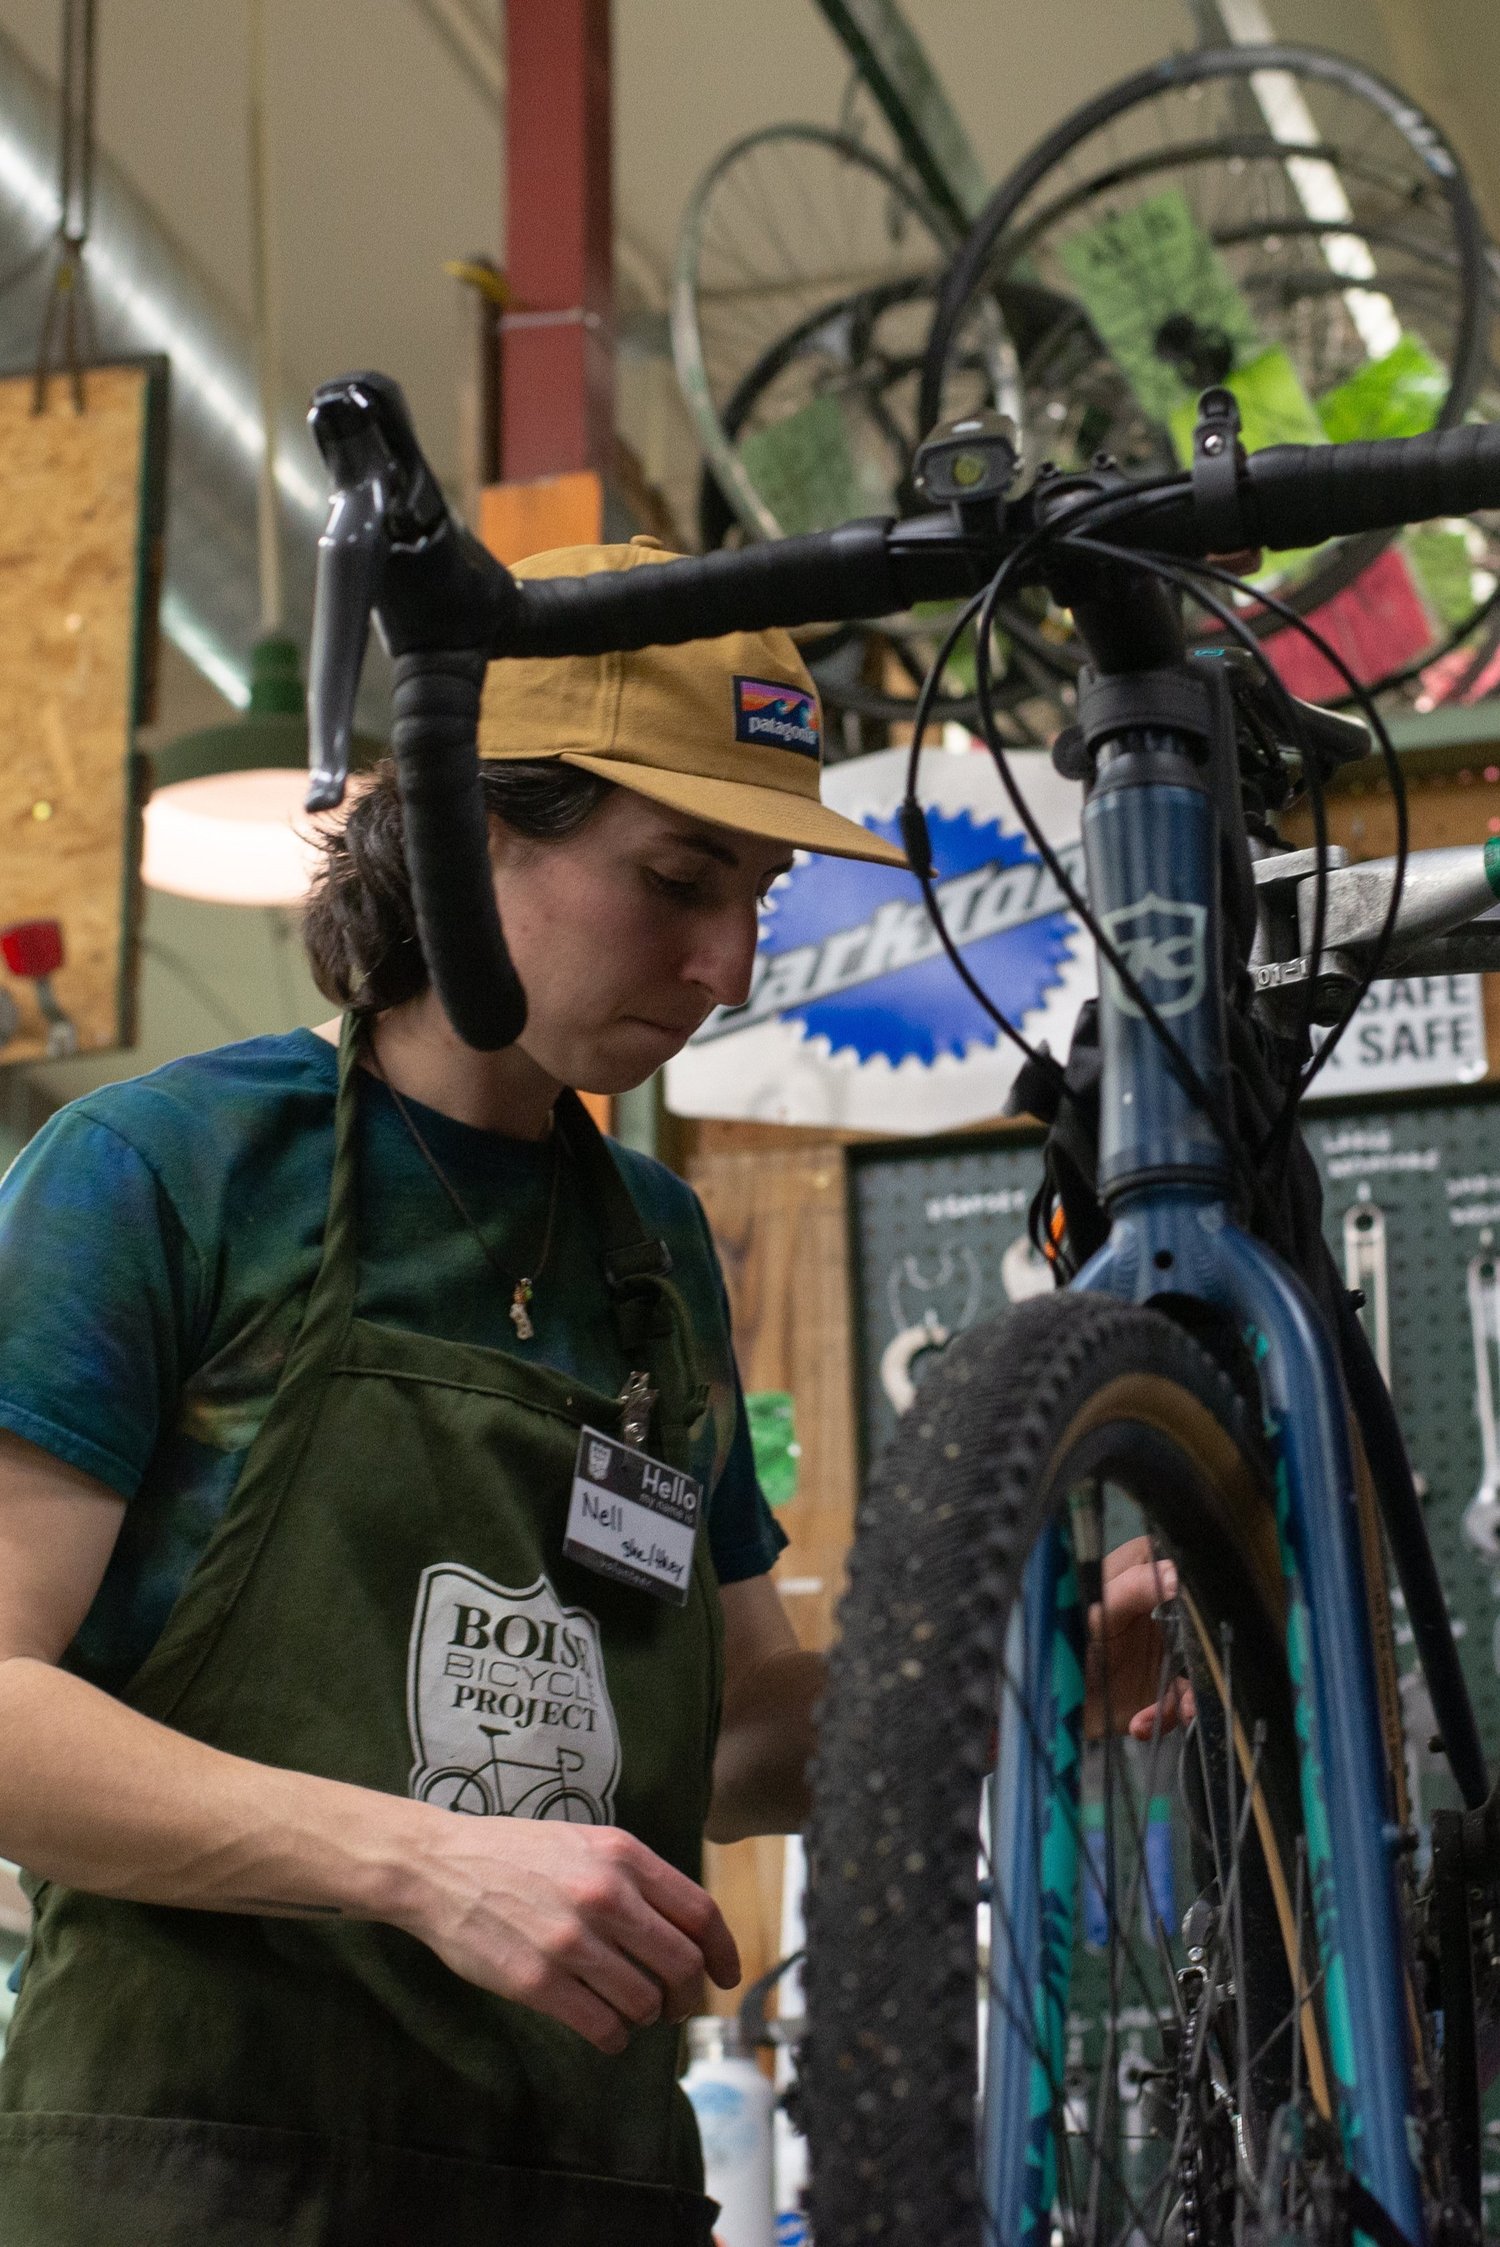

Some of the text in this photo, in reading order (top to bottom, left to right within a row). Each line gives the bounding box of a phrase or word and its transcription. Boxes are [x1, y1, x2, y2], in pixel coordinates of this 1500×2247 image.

[1357, 1012, 1474, 1066] SAFE
[640, 1463, 697, 1511] Hello
[581, 1491, 623, 1533] Nell
[450, 1684, 598, 1732] PROJECT
